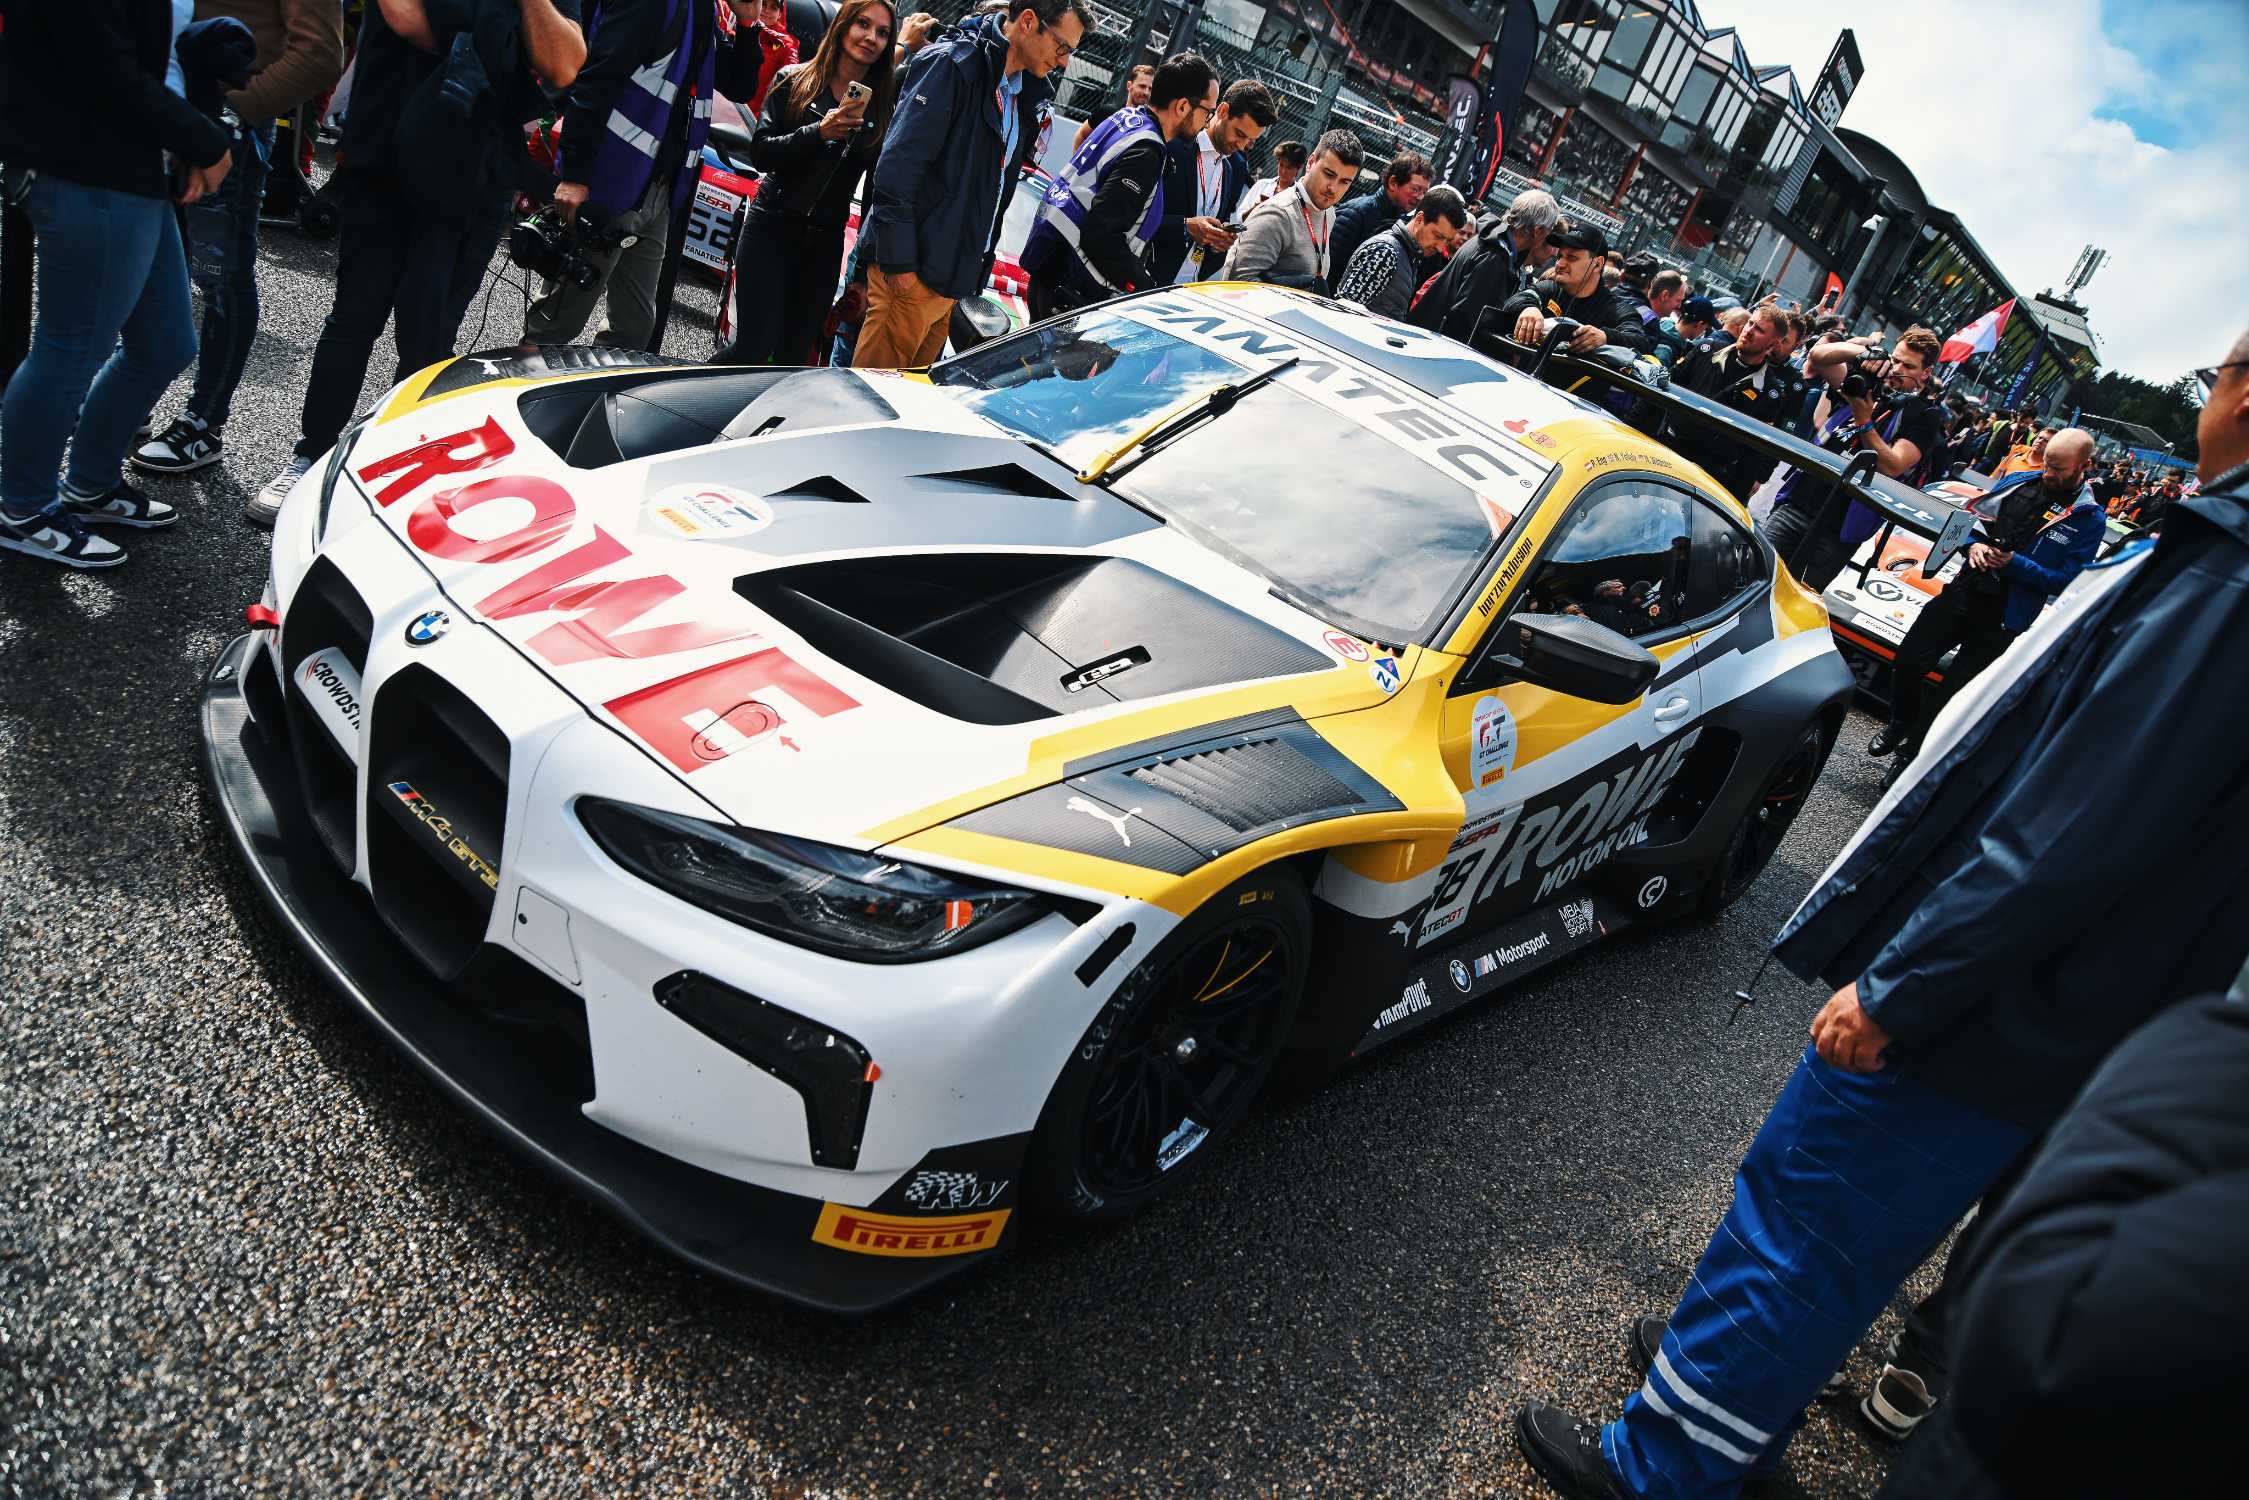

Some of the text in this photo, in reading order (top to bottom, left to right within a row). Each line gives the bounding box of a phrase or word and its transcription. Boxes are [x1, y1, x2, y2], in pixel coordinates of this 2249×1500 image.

[687, 207, 732, 250] 52
[1127, 301, 1519, 481] FANATEC
[357, 414, 864, 774] ROWE
[314, 661, 361, 732] CROWDST
[1476, 725, 1704, 905] ROWE
[1420, 906, 1465, 937] ATECGT
[1559, 901, 1581, 922] MBA
[1567, 923, 1589, 938] SPORT
[1498, 931, 1551, 967] Motorsport
[918, 1175, 1010, 1209] KW
[832, 1214, 993, 1250] PIRELLI
